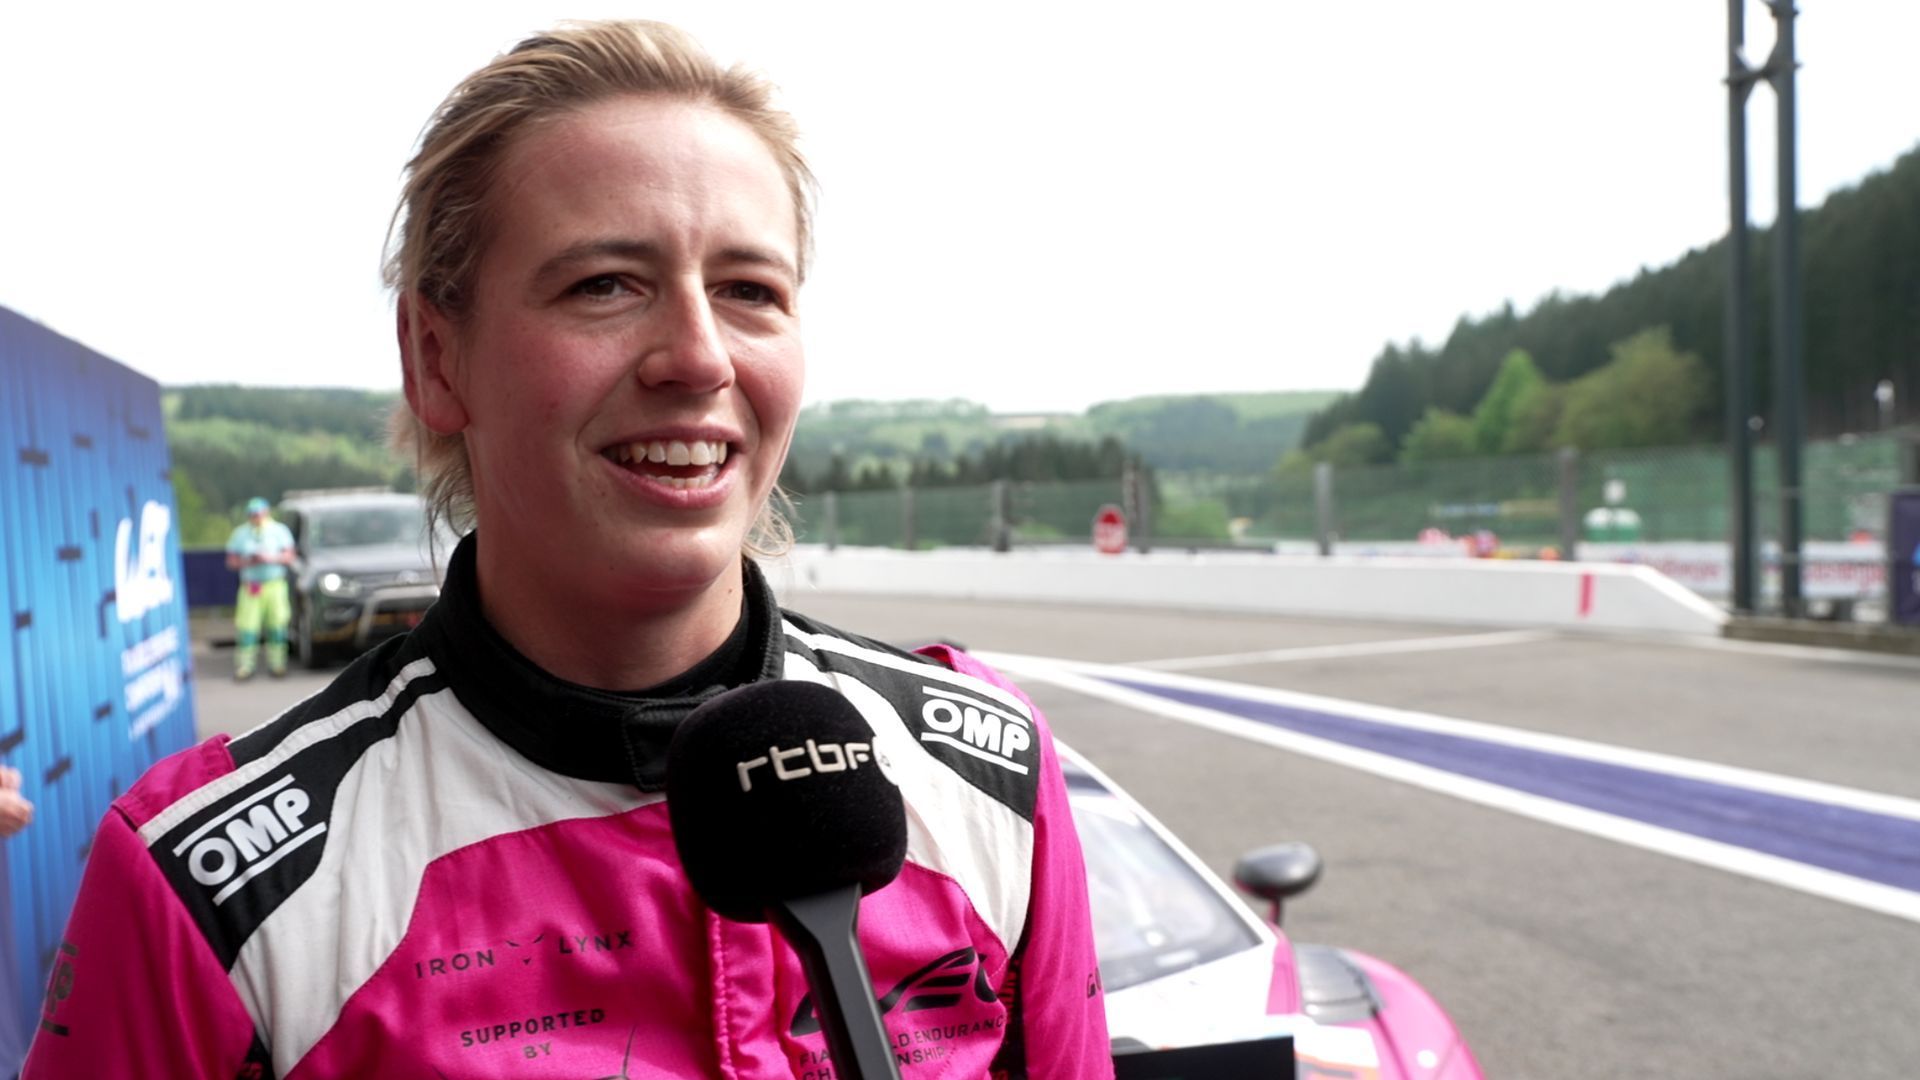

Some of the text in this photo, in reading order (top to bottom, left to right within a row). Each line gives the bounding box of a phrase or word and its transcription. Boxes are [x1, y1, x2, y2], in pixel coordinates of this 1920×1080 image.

[921, 698, 1031, 759] OMP
[188, 787, 311, 887] OMP
[415, 930, 633, 979] IRON LYNX
[460, 1008, 606, 1048] SUPPORTED
[914, 1014, 1005, 1044] ENDURANC
[523, 1041, 552, 1060] BY
